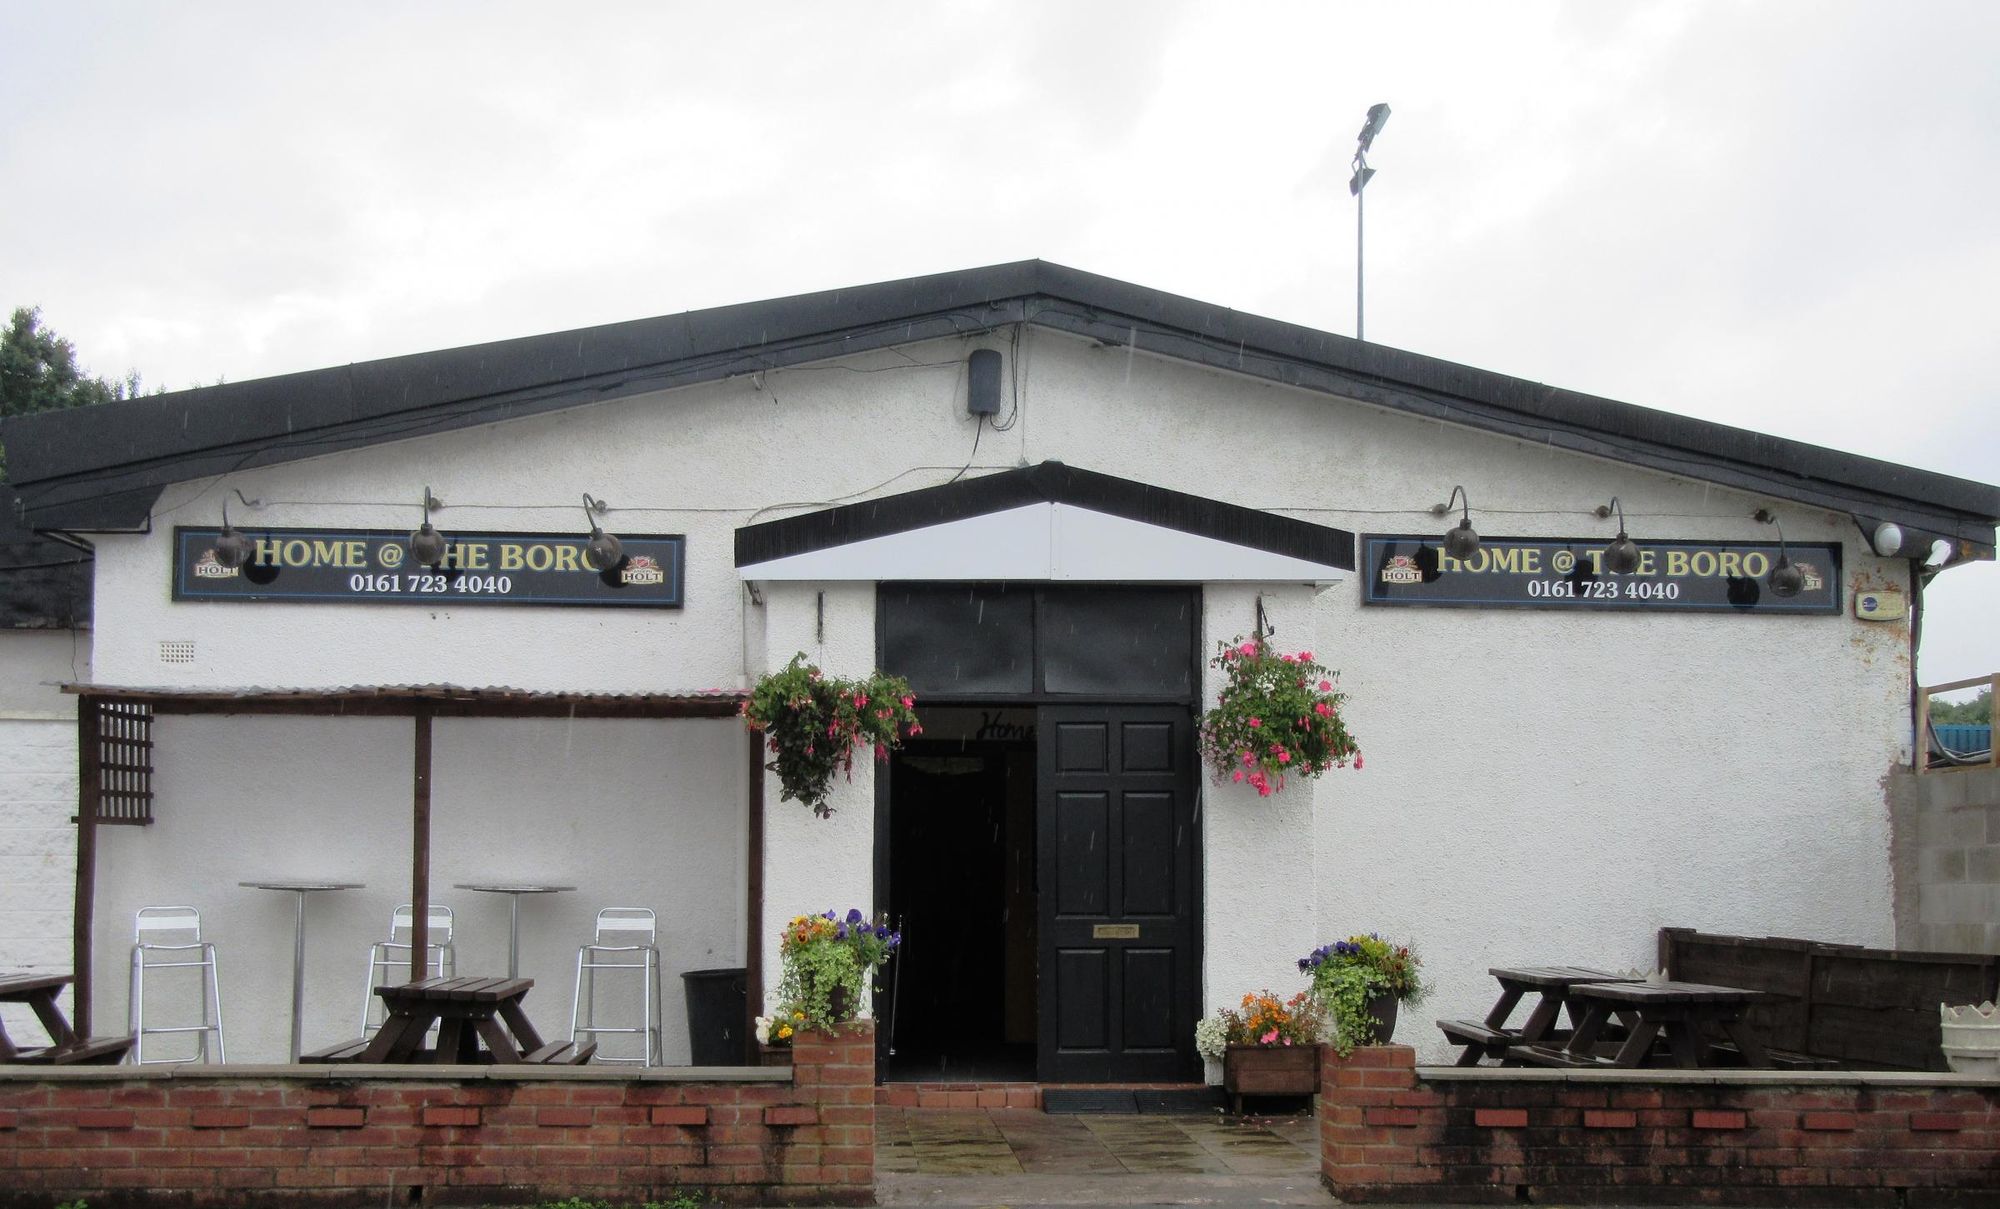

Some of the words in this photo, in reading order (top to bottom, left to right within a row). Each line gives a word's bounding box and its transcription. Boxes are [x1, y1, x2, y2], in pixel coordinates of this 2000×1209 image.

[254, 540, 367, 568] HOME
[378, 543, 404, 567] @
[421, 543, 489, 570] HE
[1436, 547, 1543, 574] HOME
[1552, 550, 1576, 574] @
[1586, 550, 1656, 576] TE
[1667, 551, 1770, 577] BORO
[350, 574, 401, 592] 0161
[408, 575, 448, 592] 723
[454, 575, 512, 594] 4040
[624, 573, 660, 581] HOLT
[1385, 572, 1420, 580] HOLT
[1527, 580, 1575, 598] 0161
[1581, 581, 1619, 598] 723
[1625, 582, 1680, 599] 4040
[976, 711, 1036, 741] Home
